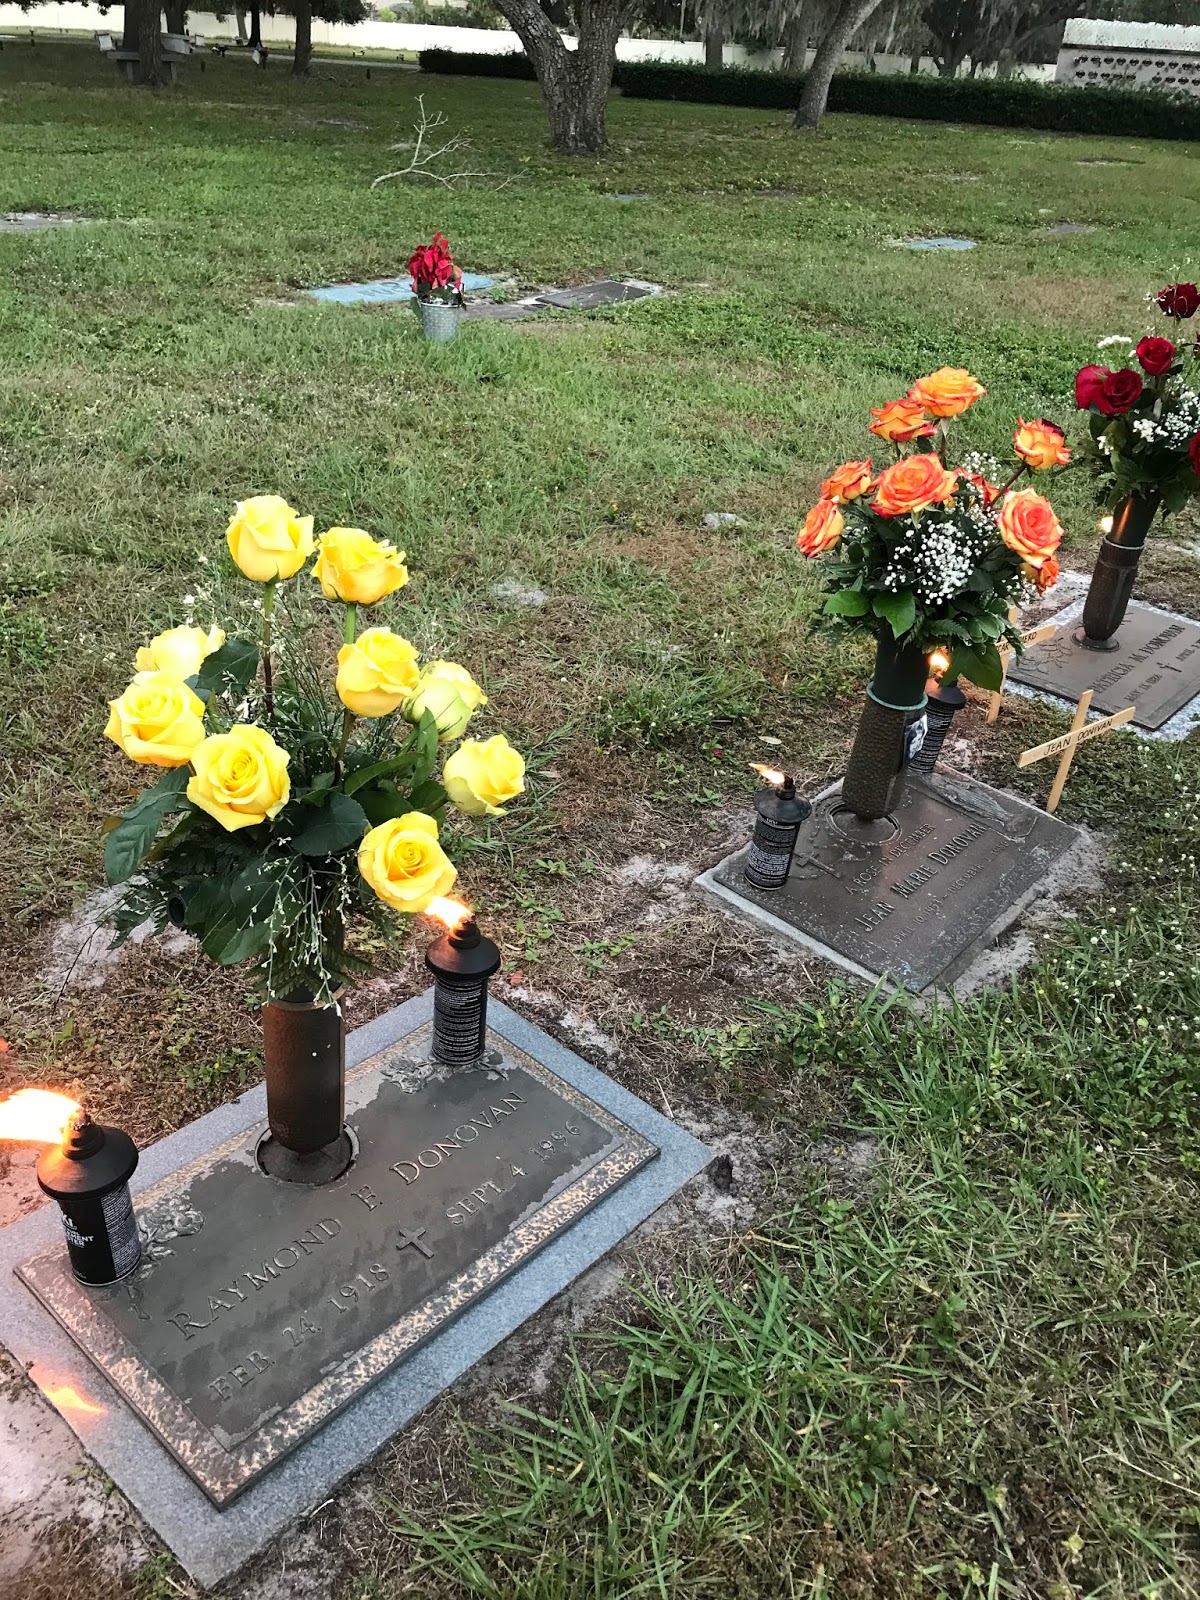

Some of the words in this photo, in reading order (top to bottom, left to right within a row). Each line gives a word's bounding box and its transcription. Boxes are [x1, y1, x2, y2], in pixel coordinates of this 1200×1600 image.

[1139, 624, 1186, 655] DONOVAN
[1043, 736, 1072, 755] JEAN
[844, 885, 858, 896] A
[853, 865, 883, 887] ROSE
[878, 855, 894, 868] IN
[889, 822, 937, 858] DECEMBER
[854, 900, 896, 932] JEAN
[889, 864, 939, 899] MARIE
[926, 821, 988, 866] DONOVAN
[947, 863, 985, 895] DECEMBER
[166, 1217, 343, 1341] RAYMOND
[388, 1090, 528, 1186] DONOVAN
[207, 1349, 277, 1401] FEB.
[326, 1263, 390, 1315] 1918
[528, 1119, 582, 1164] 1996
